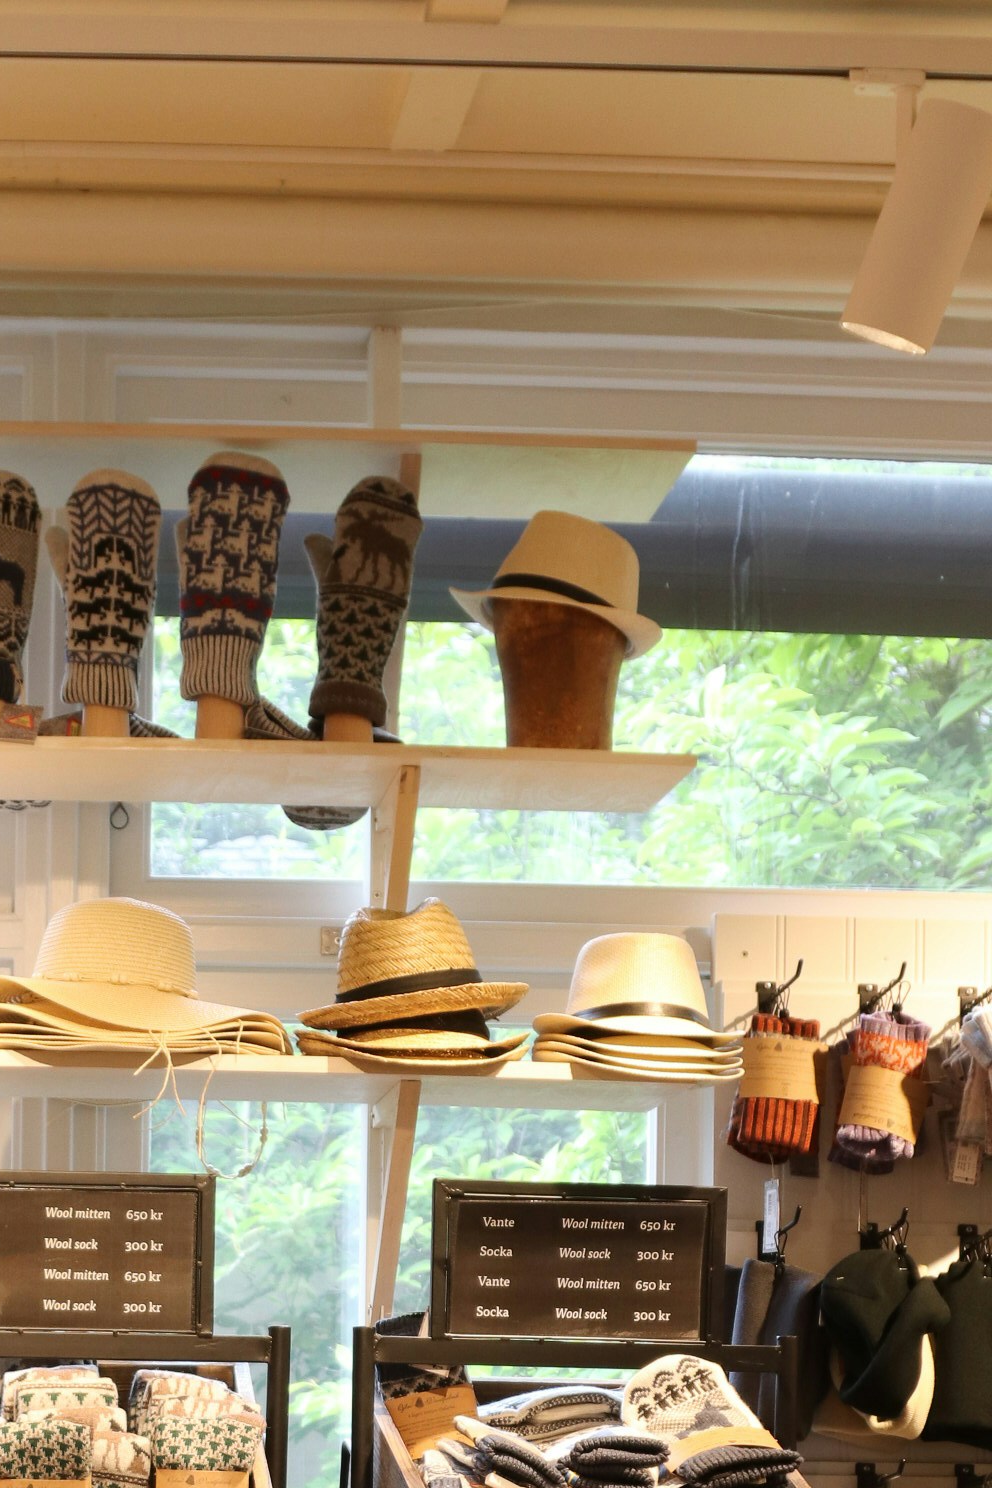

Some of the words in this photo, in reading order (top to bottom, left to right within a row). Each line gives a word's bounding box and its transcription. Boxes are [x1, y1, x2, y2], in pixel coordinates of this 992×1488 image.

[46, 1207, 73, 1218] Wool
[75, 1208, 110, 1219] mitten
[126, 1210, 148, 1221] 650
[150, 1209, 163, 1220] kr
[483, 1217, 514, 1227] Vante
[563, 1218, 588, 1228] Wool
[591, 1219, 624, 1229] mitten
[640, 1221, 660, 1231] 650
[663, 1220, 675, 1230] kr
[45, 1238, 72, 1249] Wool
[74, 1239, 98, 1250] sock
[125, 1242, 148, 1251] 300
[150, 1240, 163, 1251] kr
[480, 1246, 512, 1256] Socka
[560, 1248, 586, 1258] Wool
[588, 1248, 610, 1259] sock
[637, 1251, 659, 1260] 300
[662, 1250, 674, 1260] kr
[44, 1269, 71, 1279] Wool
[74, 1270, 109, 1280] mitten
[124, 1272, 146, 1282] 650
[149, 1271, 161, 1282] kr
[478, 1276, 510, 1286] Vante
[557, 1278, 583, 1288] Wool
[586, 1279, 620, 1289] mitten
[636, 1280, 656, 1291] 650
[659, 1280, 671, 1290] kr
[43, 1299, 70, 1310] Wool
[72, 1300, 96, 1311] sock
[124, 1303, 146, 1313] 300
[149, 1302, 162, 1312] kr
[476, 1306, 509, 1317] Socka
[556, 1308, 582, 1319] Wool
[584, 1309, 607, 1319] sock
[634, 1312, 656, 1321] 300
[658, 1310, 671, 1321] kr
